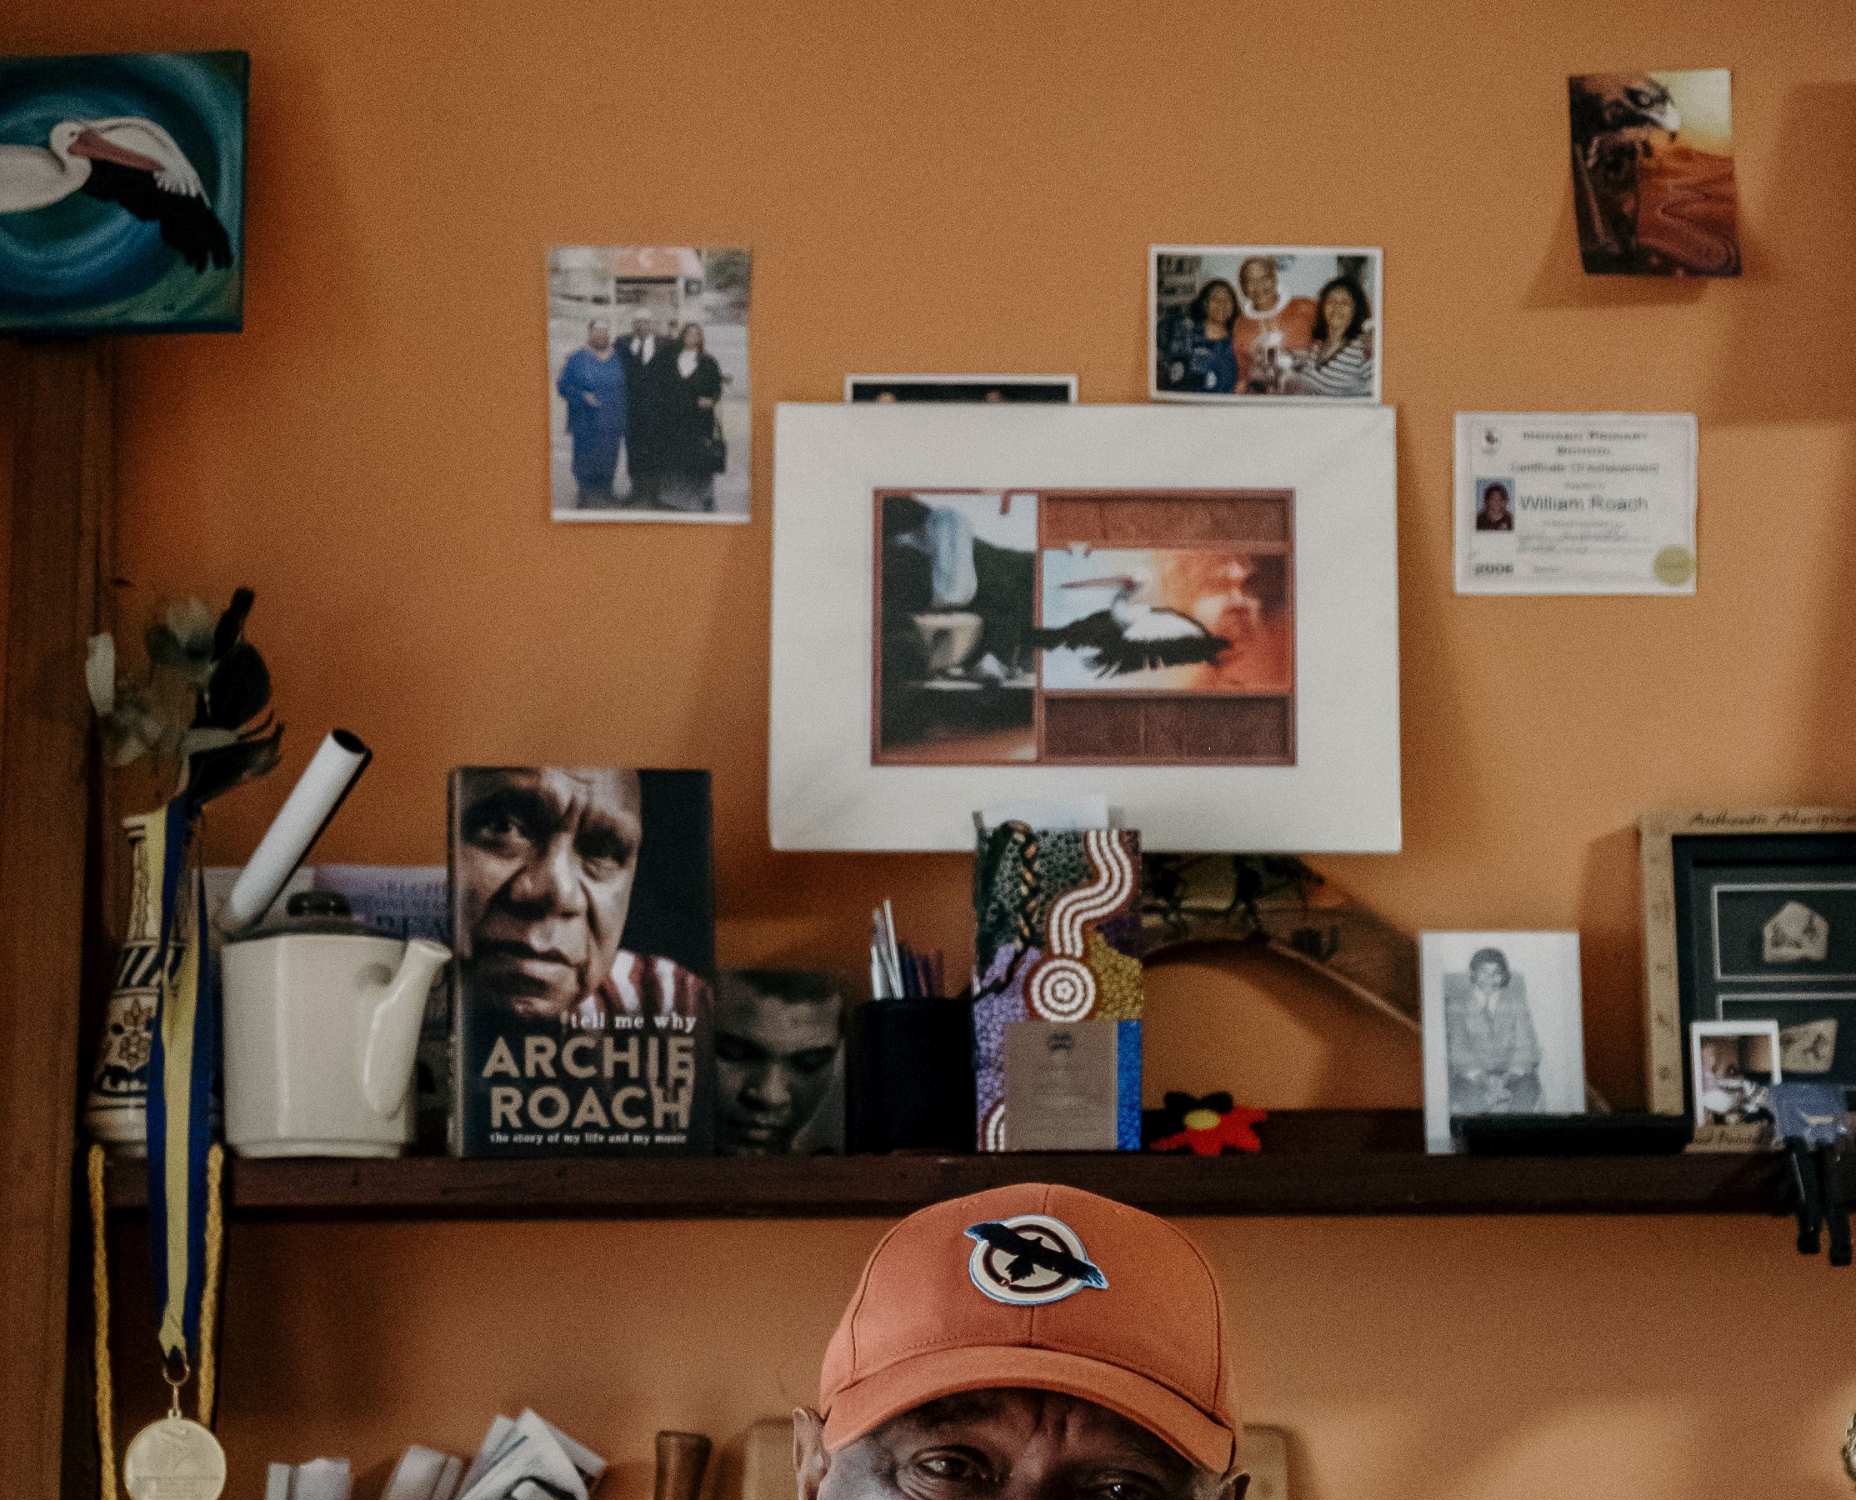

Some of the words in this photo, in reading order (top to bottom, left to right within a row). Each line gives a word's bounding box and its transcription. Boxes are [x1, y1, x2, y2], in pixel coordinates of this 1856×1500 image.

[1520, 496, 1584, 512] William
[1591, 495, 1649, 513] Roach
[571, 1012, 606, 1030] tell
[615, 1015, 645, 1030] me
[654, 1013, 697, 1034] why
[482, 1035, 695, 1079] ARCHIE
[490, 1086, 691, 1130] ROACH
[490, 1132, 509, 1143] the
[513, 1133, 543, 1145] story
[548, 1132, 560, 1143] of
[564, 1134, 580, 1145] my
[585, 1132, 604, 1143] life
[609, 1133, 629, 1143] and
[633, 1134, 650, 1145] my
[655, 1133, 687, 1144] music
